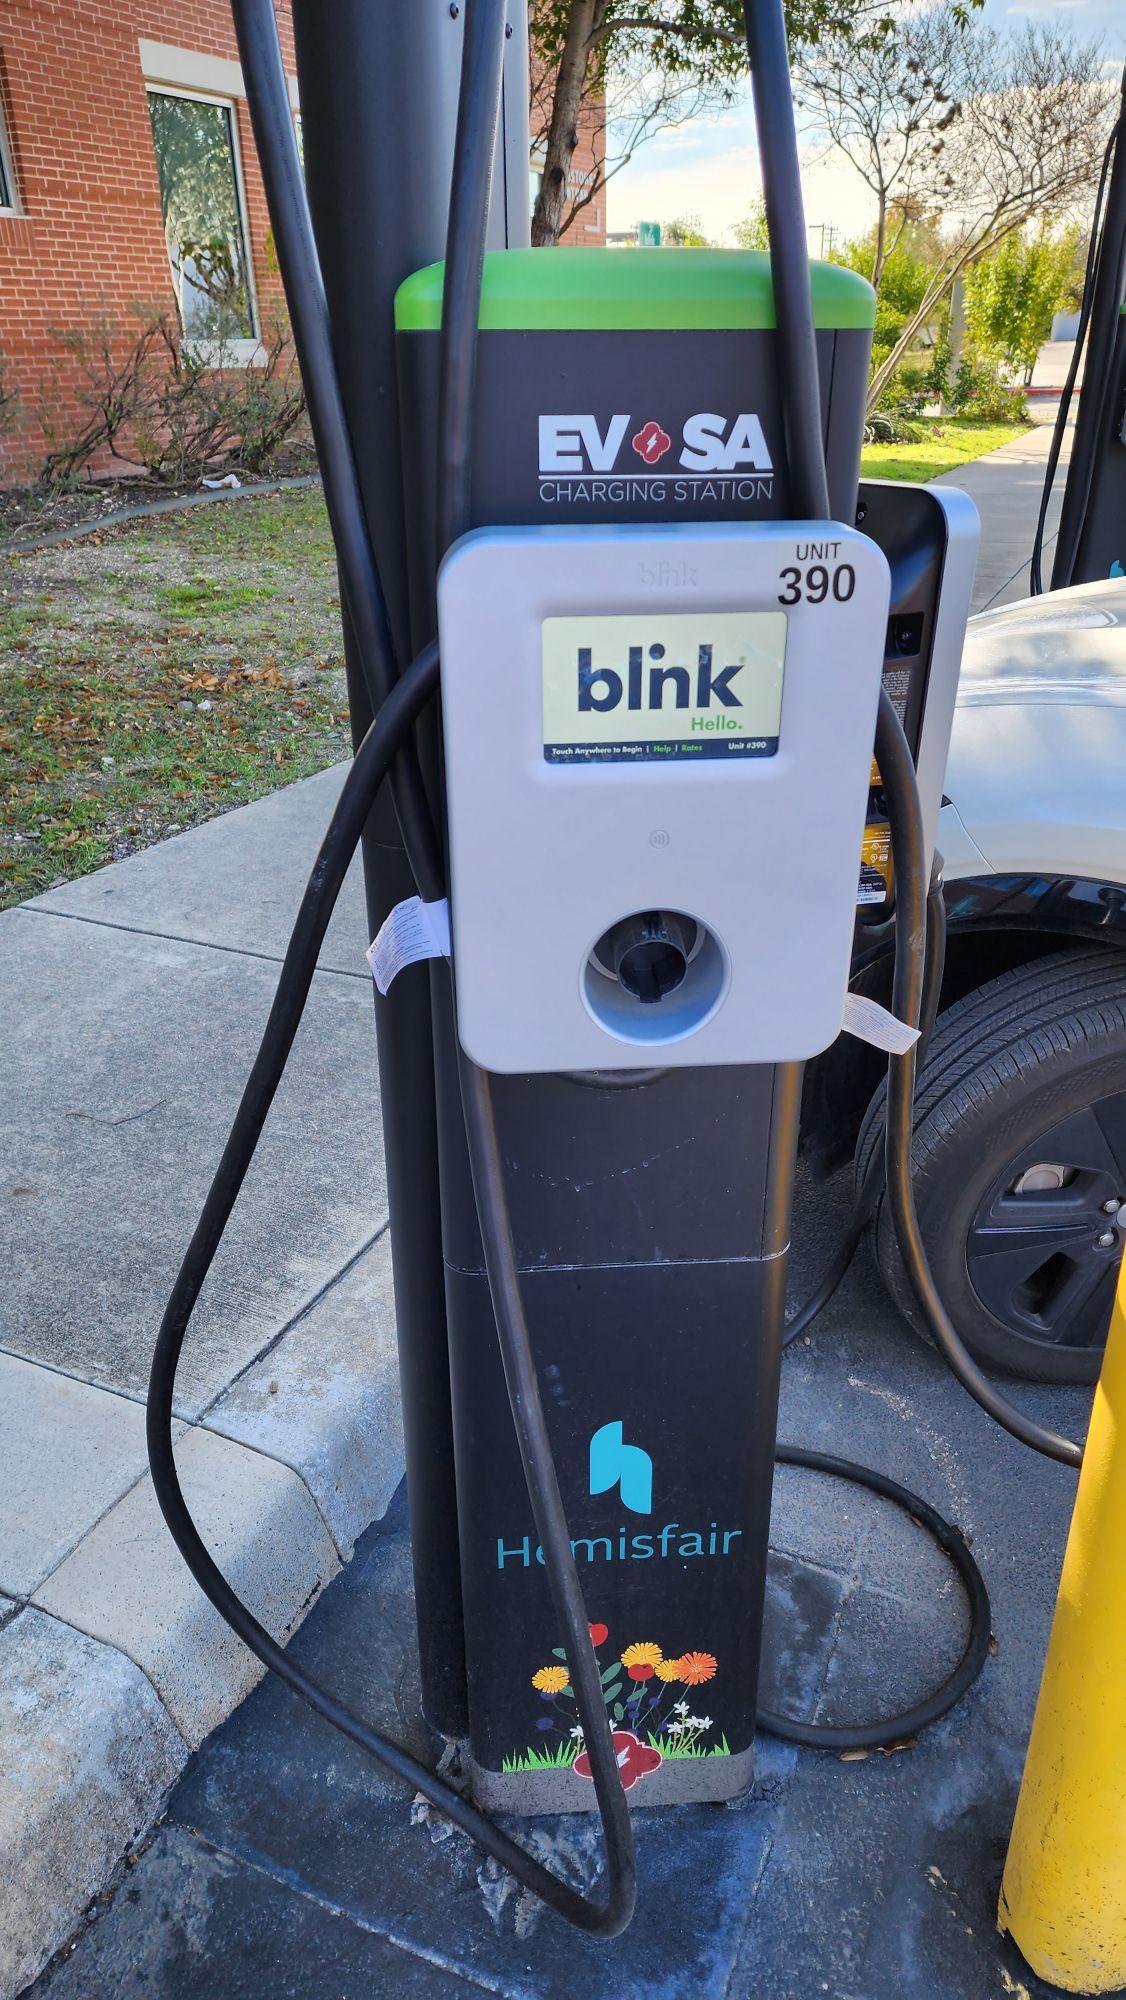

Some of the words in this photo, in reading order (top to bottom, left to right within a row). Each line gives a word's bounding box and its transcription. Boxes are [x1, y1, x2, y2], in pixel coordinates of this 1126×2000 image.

[538, 414, 631, 472] EV
[678, 413, 774, 472] SA
[539, 481, 666, 503] CHARGING
[673, 480, 773, 501] STATION
[796, 542, 842, 560] UNIT
[777, 563, 856, 605] 390
[577, 642, 745, 713] blink
[691, 715, 743, 731] Hello.
[552, 747, 573, 756] Touch
[575, 746, 611, 756] Anywhere
[613, 746, 621, 754] to
[622, 745, 643, 754] Begin
[653, 744, 672, 754] Help
[681, 744, 703, 752] Rates
[728, 742, 745, 750] Unit
